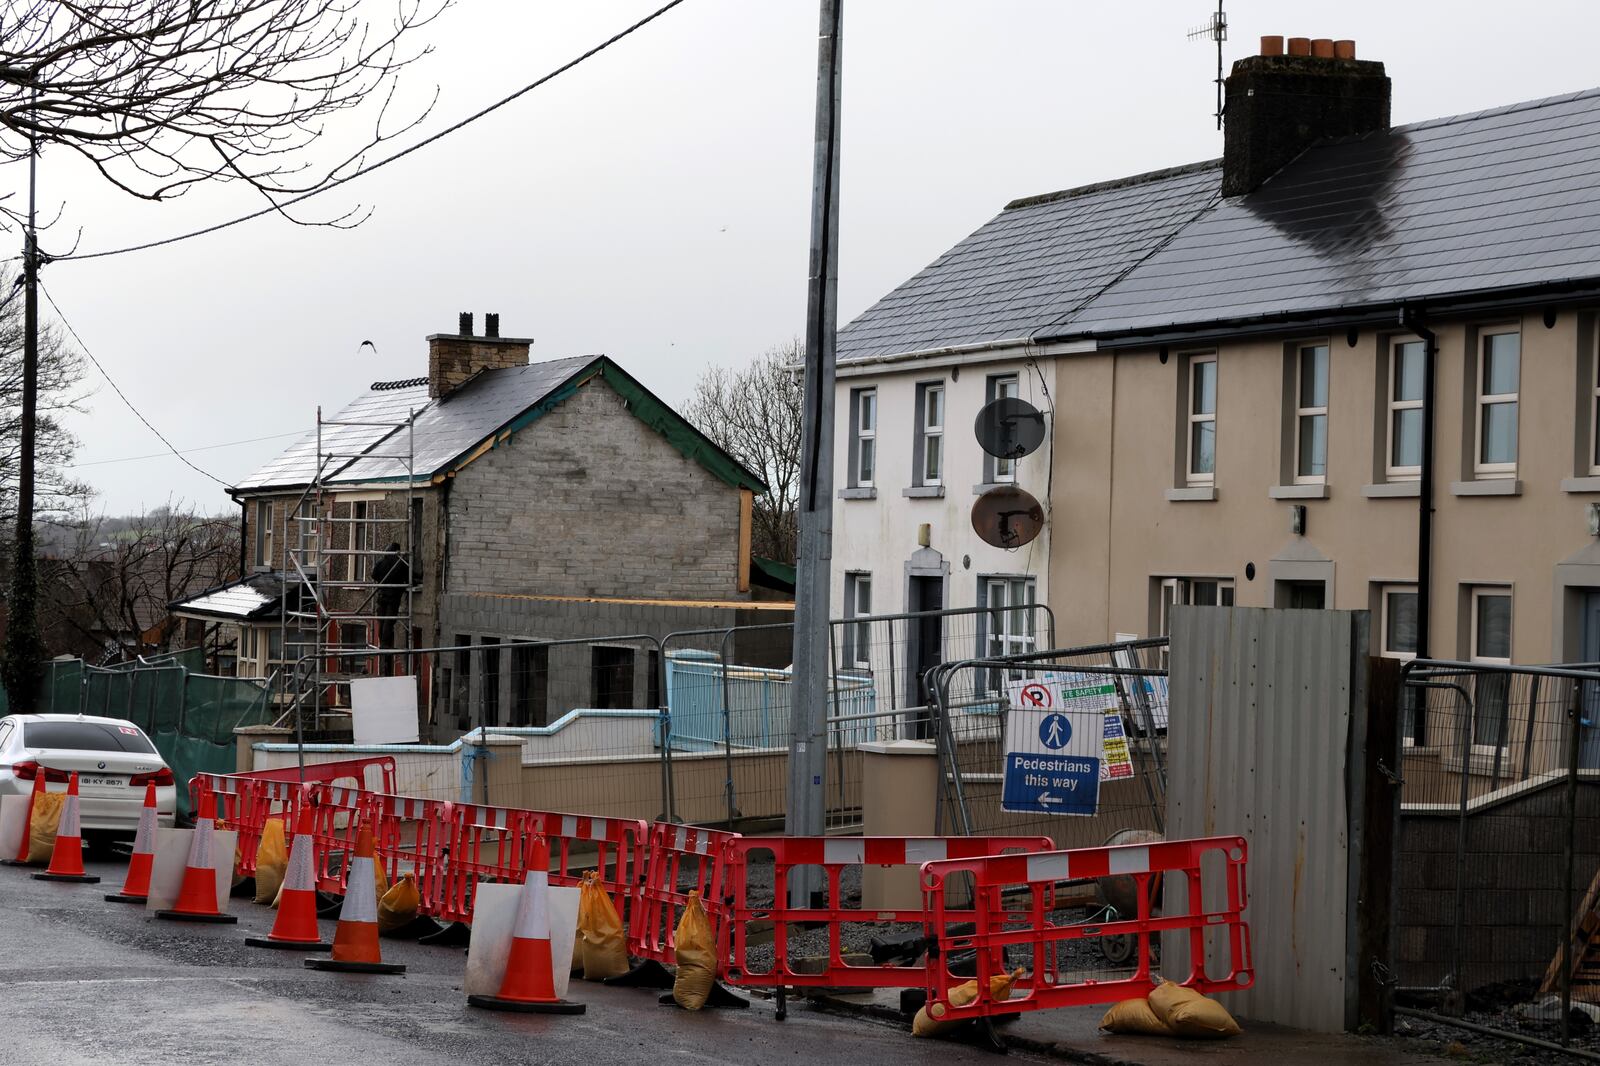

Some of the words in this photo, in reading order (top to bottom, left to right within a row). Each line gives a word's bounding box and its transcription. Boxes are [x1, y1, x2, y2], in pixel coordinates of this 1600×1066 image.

[1075, 687, 1102, 697] SAFETY
[1014, 757, 1091, 773] Pedestrians
[1025, 774, 1048, 787] this
[1053, 777, 1078, 791] way
